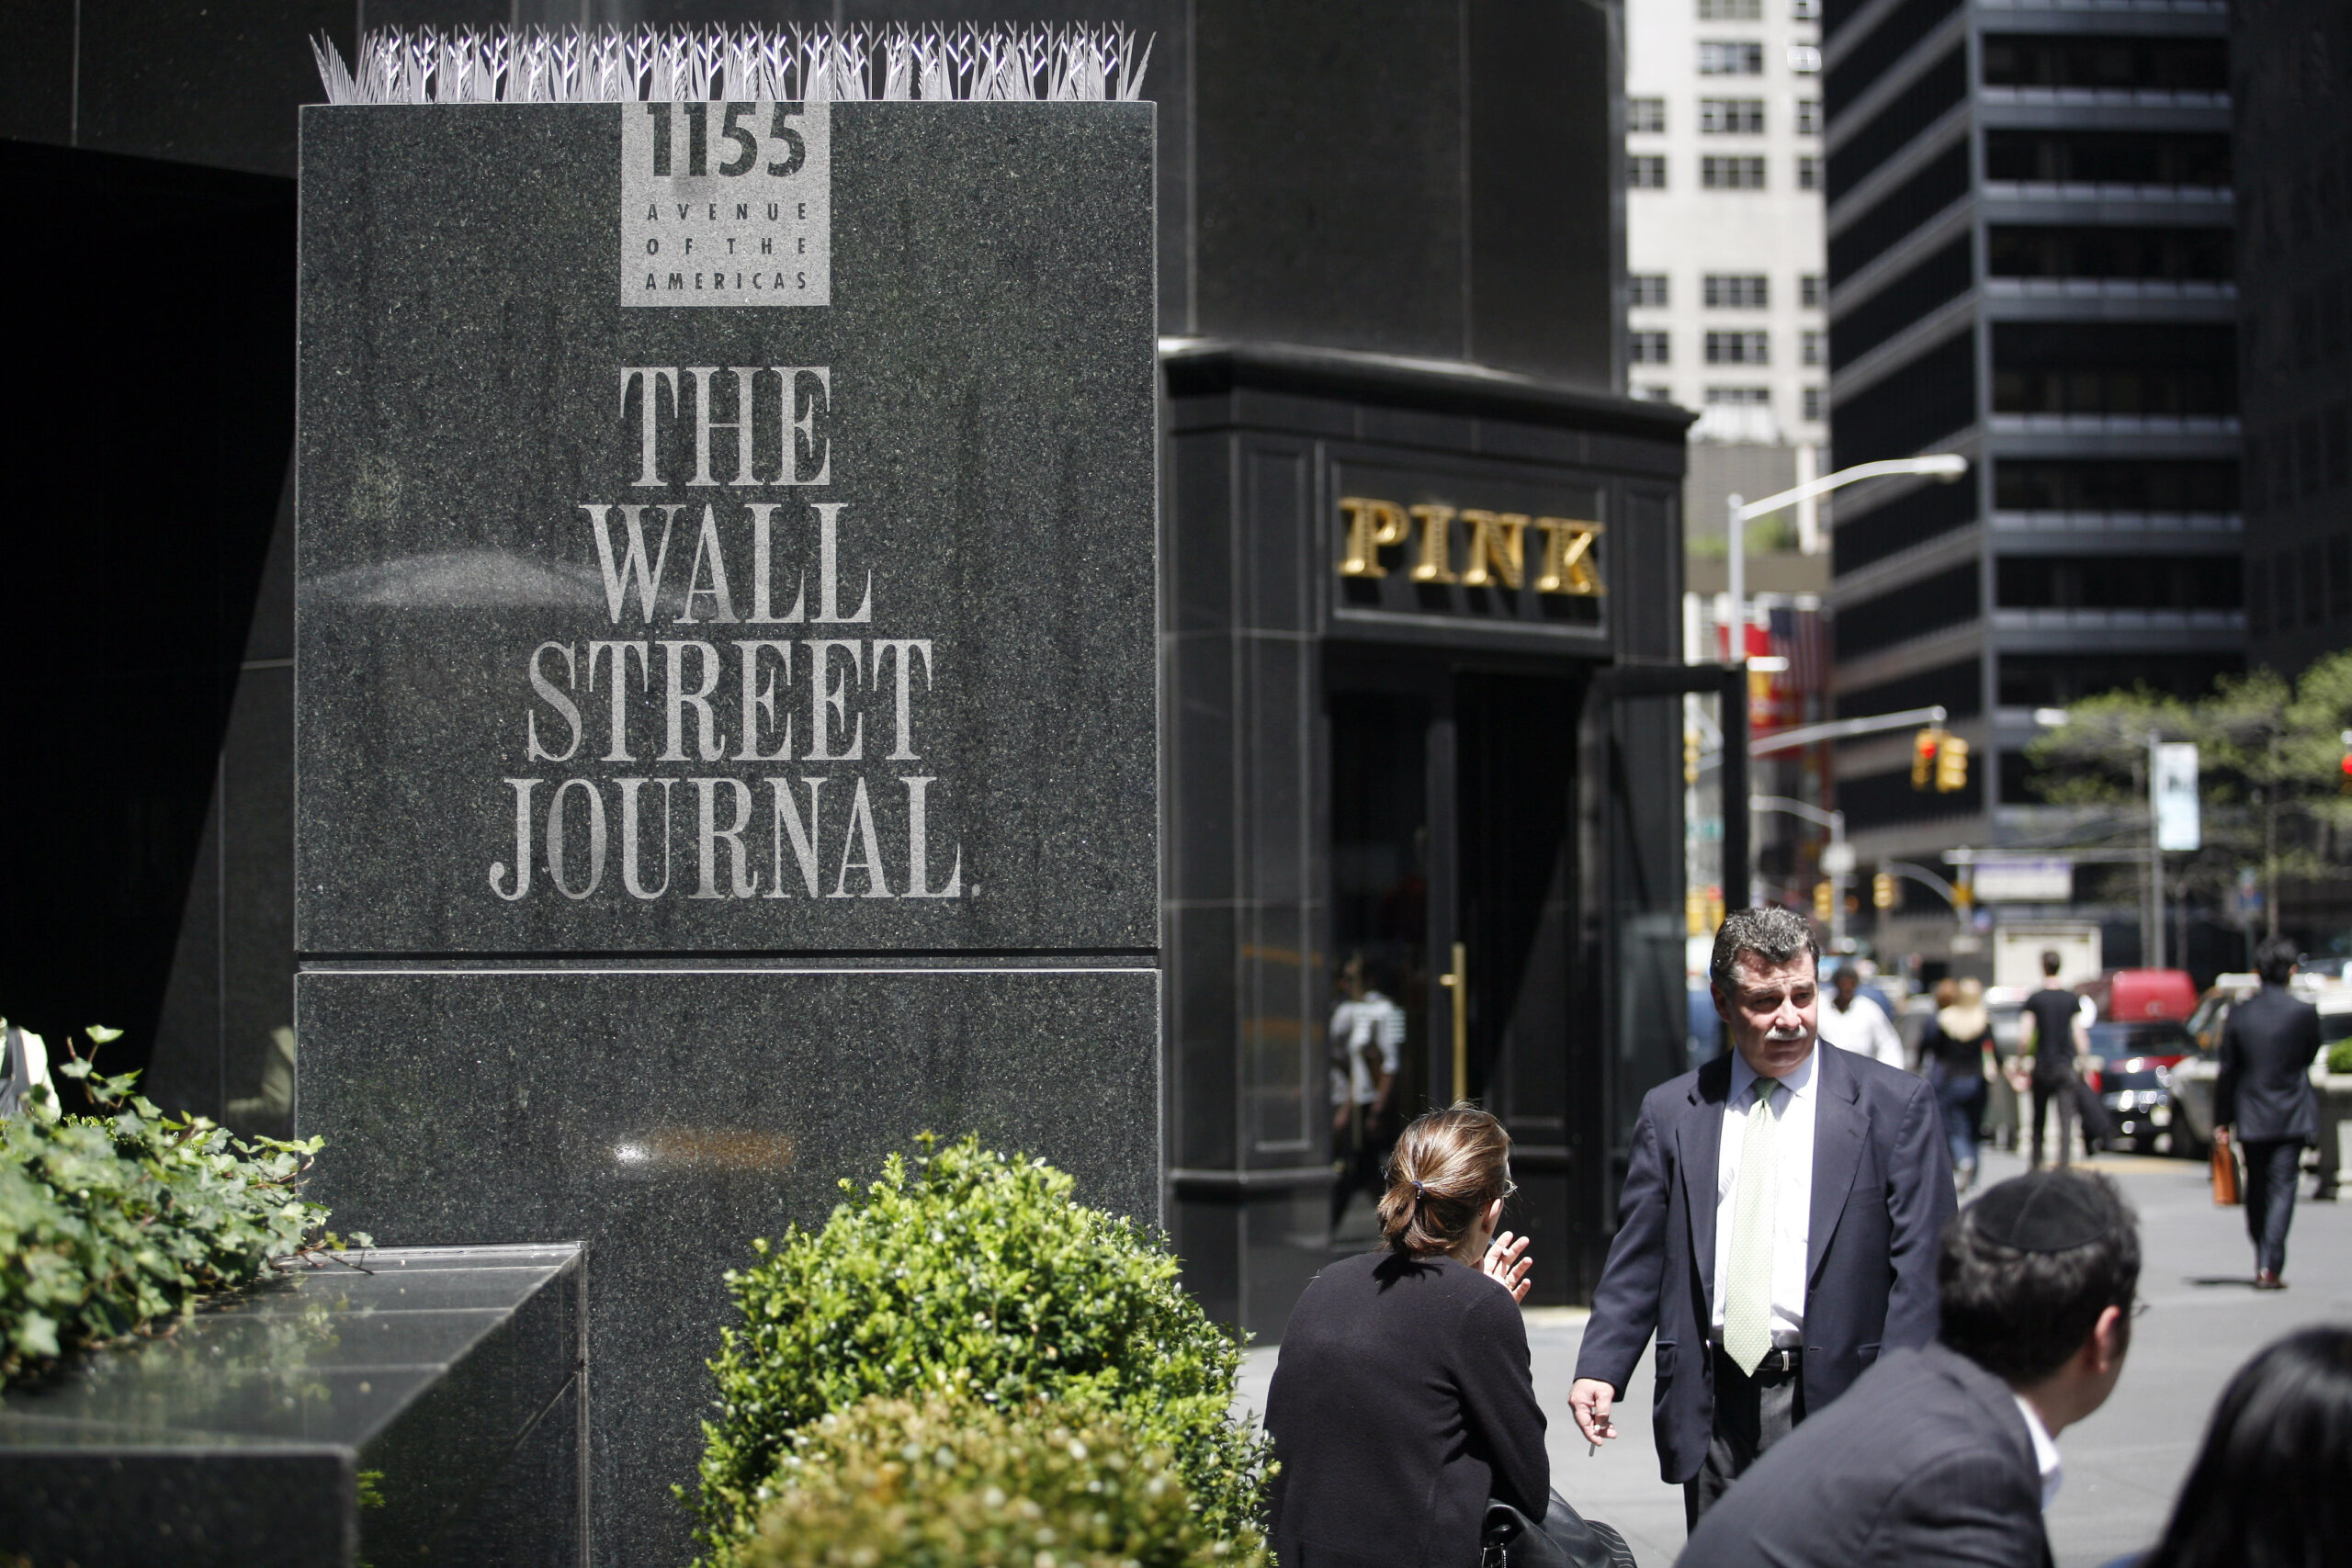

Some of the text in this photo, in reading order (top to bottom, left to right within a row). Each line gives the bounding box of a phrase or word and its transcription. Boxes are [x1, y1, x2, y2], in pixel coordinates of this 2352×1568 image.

[647, 101, 806, 177] 1155
[646, 237, 806, 255] OF THE
[647, 202, 807, 221] AVENUE
[645, 272, 807, 290] AMERICAS
[619, 366, 831, 487] THE
[578, 502, 872, 624] WALL
[1338, 497, 1607, 594] PINK
[527, 639, 933, 762] STREET
